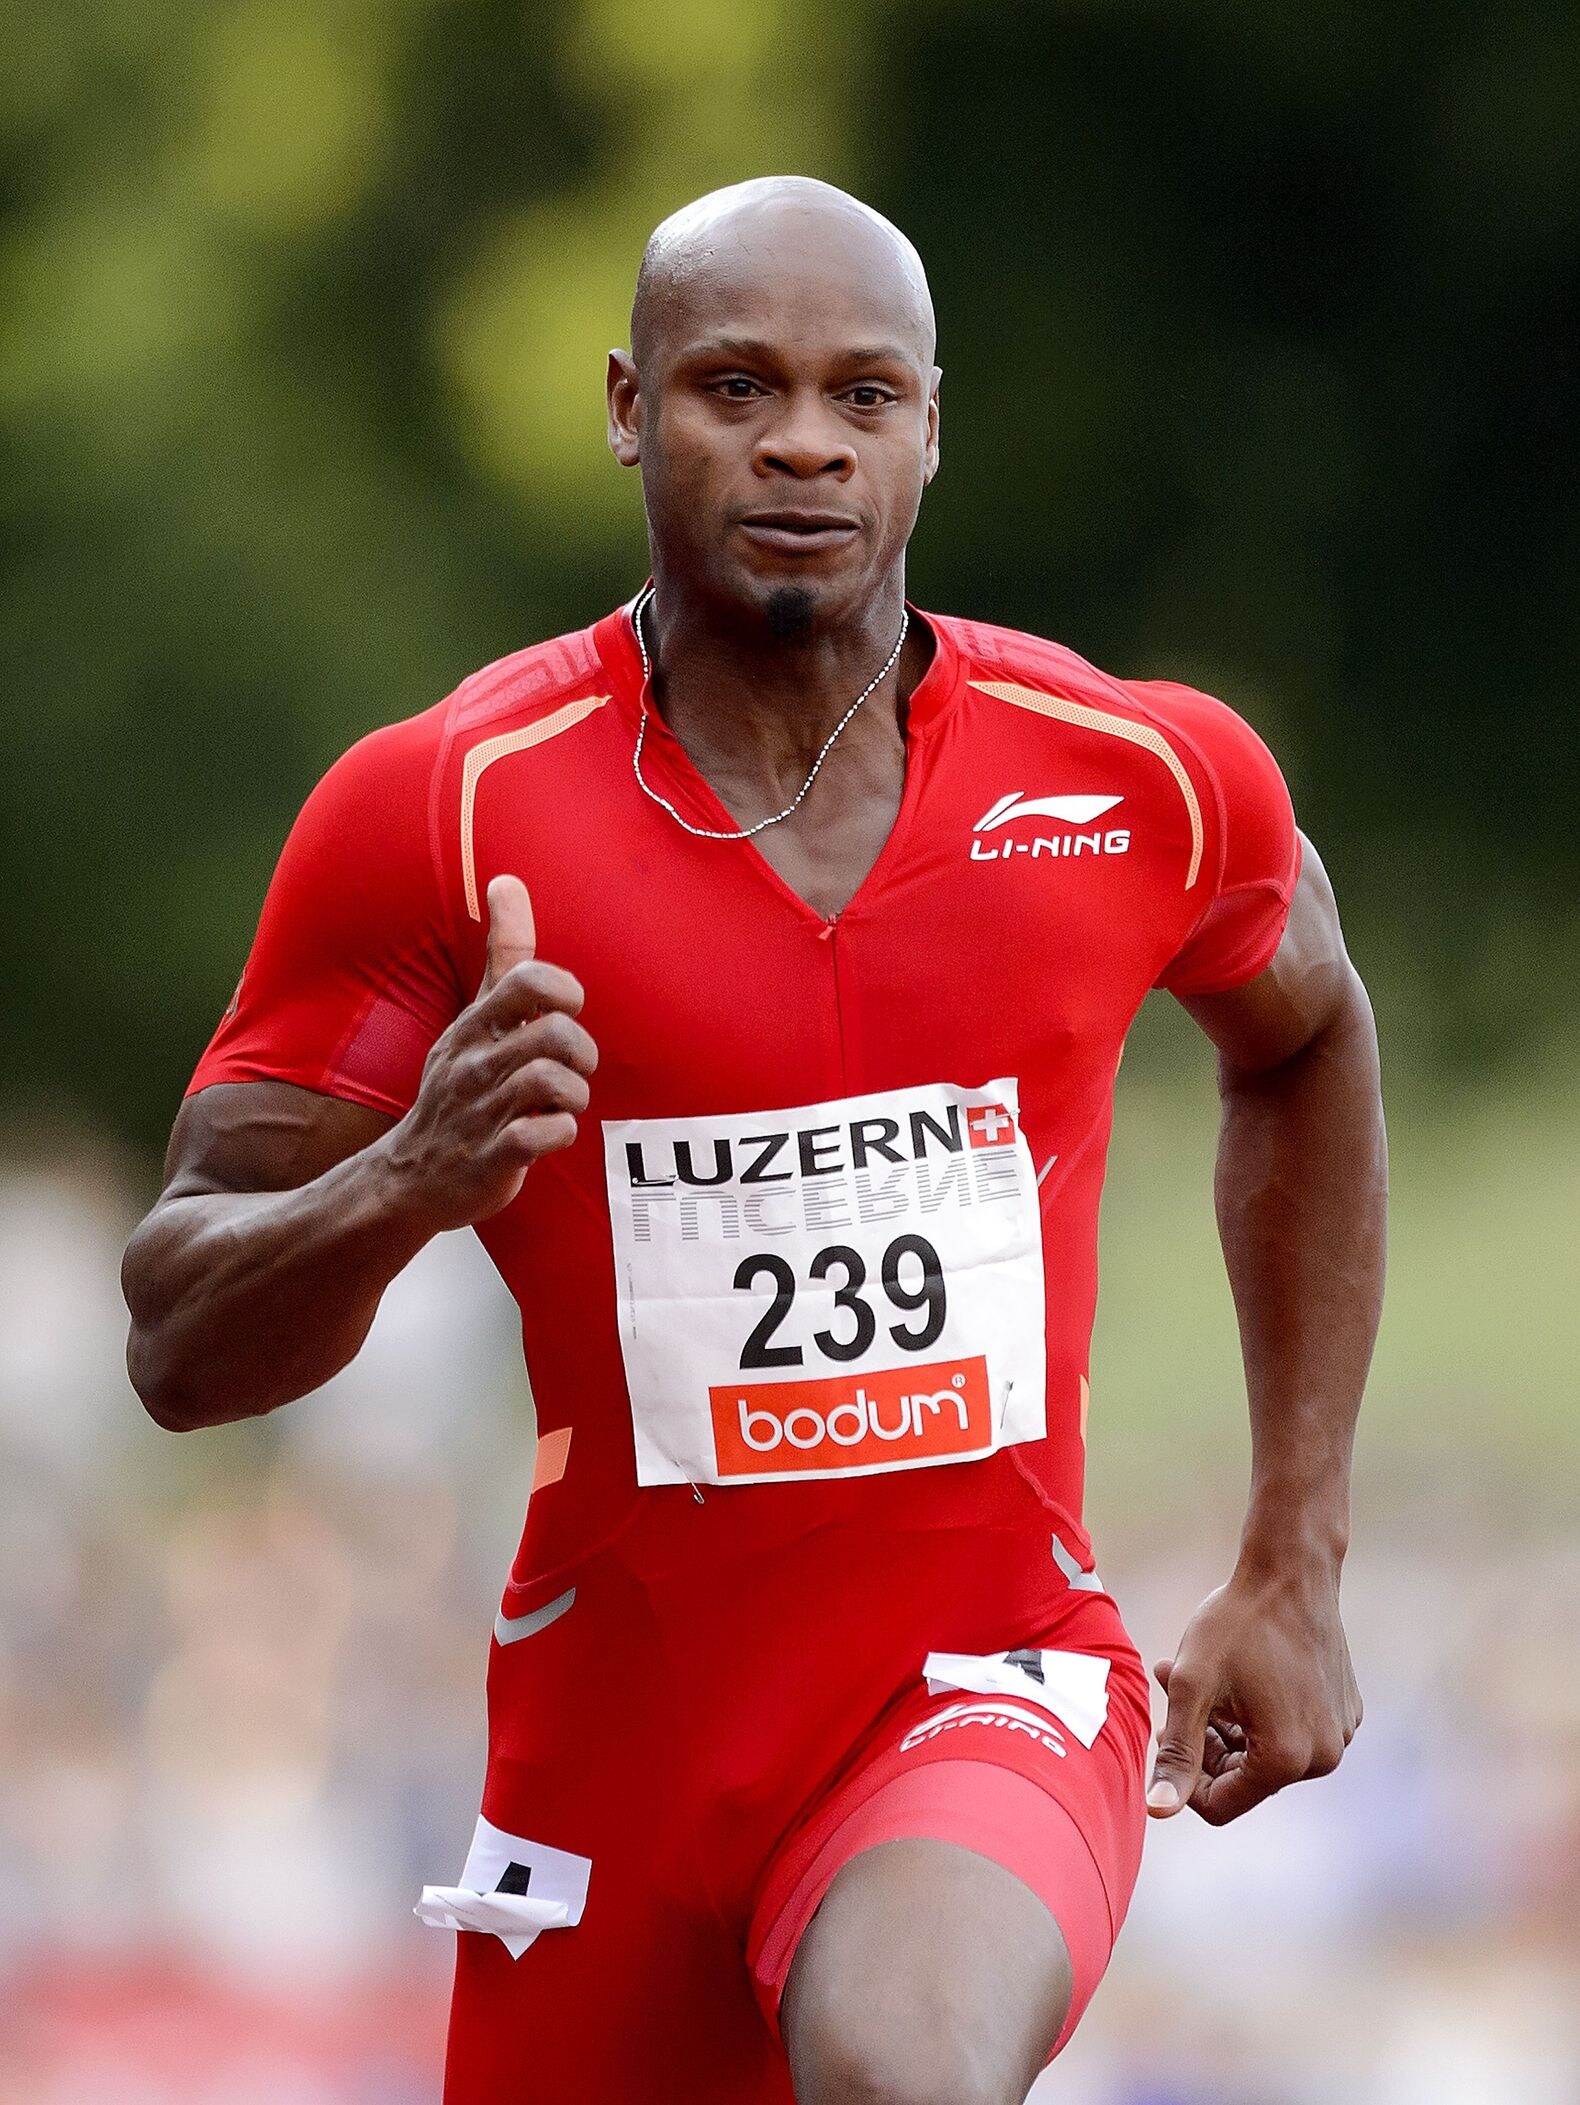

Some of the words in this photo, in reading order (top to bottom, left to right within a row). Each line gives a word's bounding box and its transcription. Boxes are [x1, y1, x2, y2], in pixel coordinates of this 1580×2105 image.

[969, 829, 1132, 861] LI-NING
[625, 1104, 964, 1188] LUZERN
[732, 1233, 947, 1370] 239
